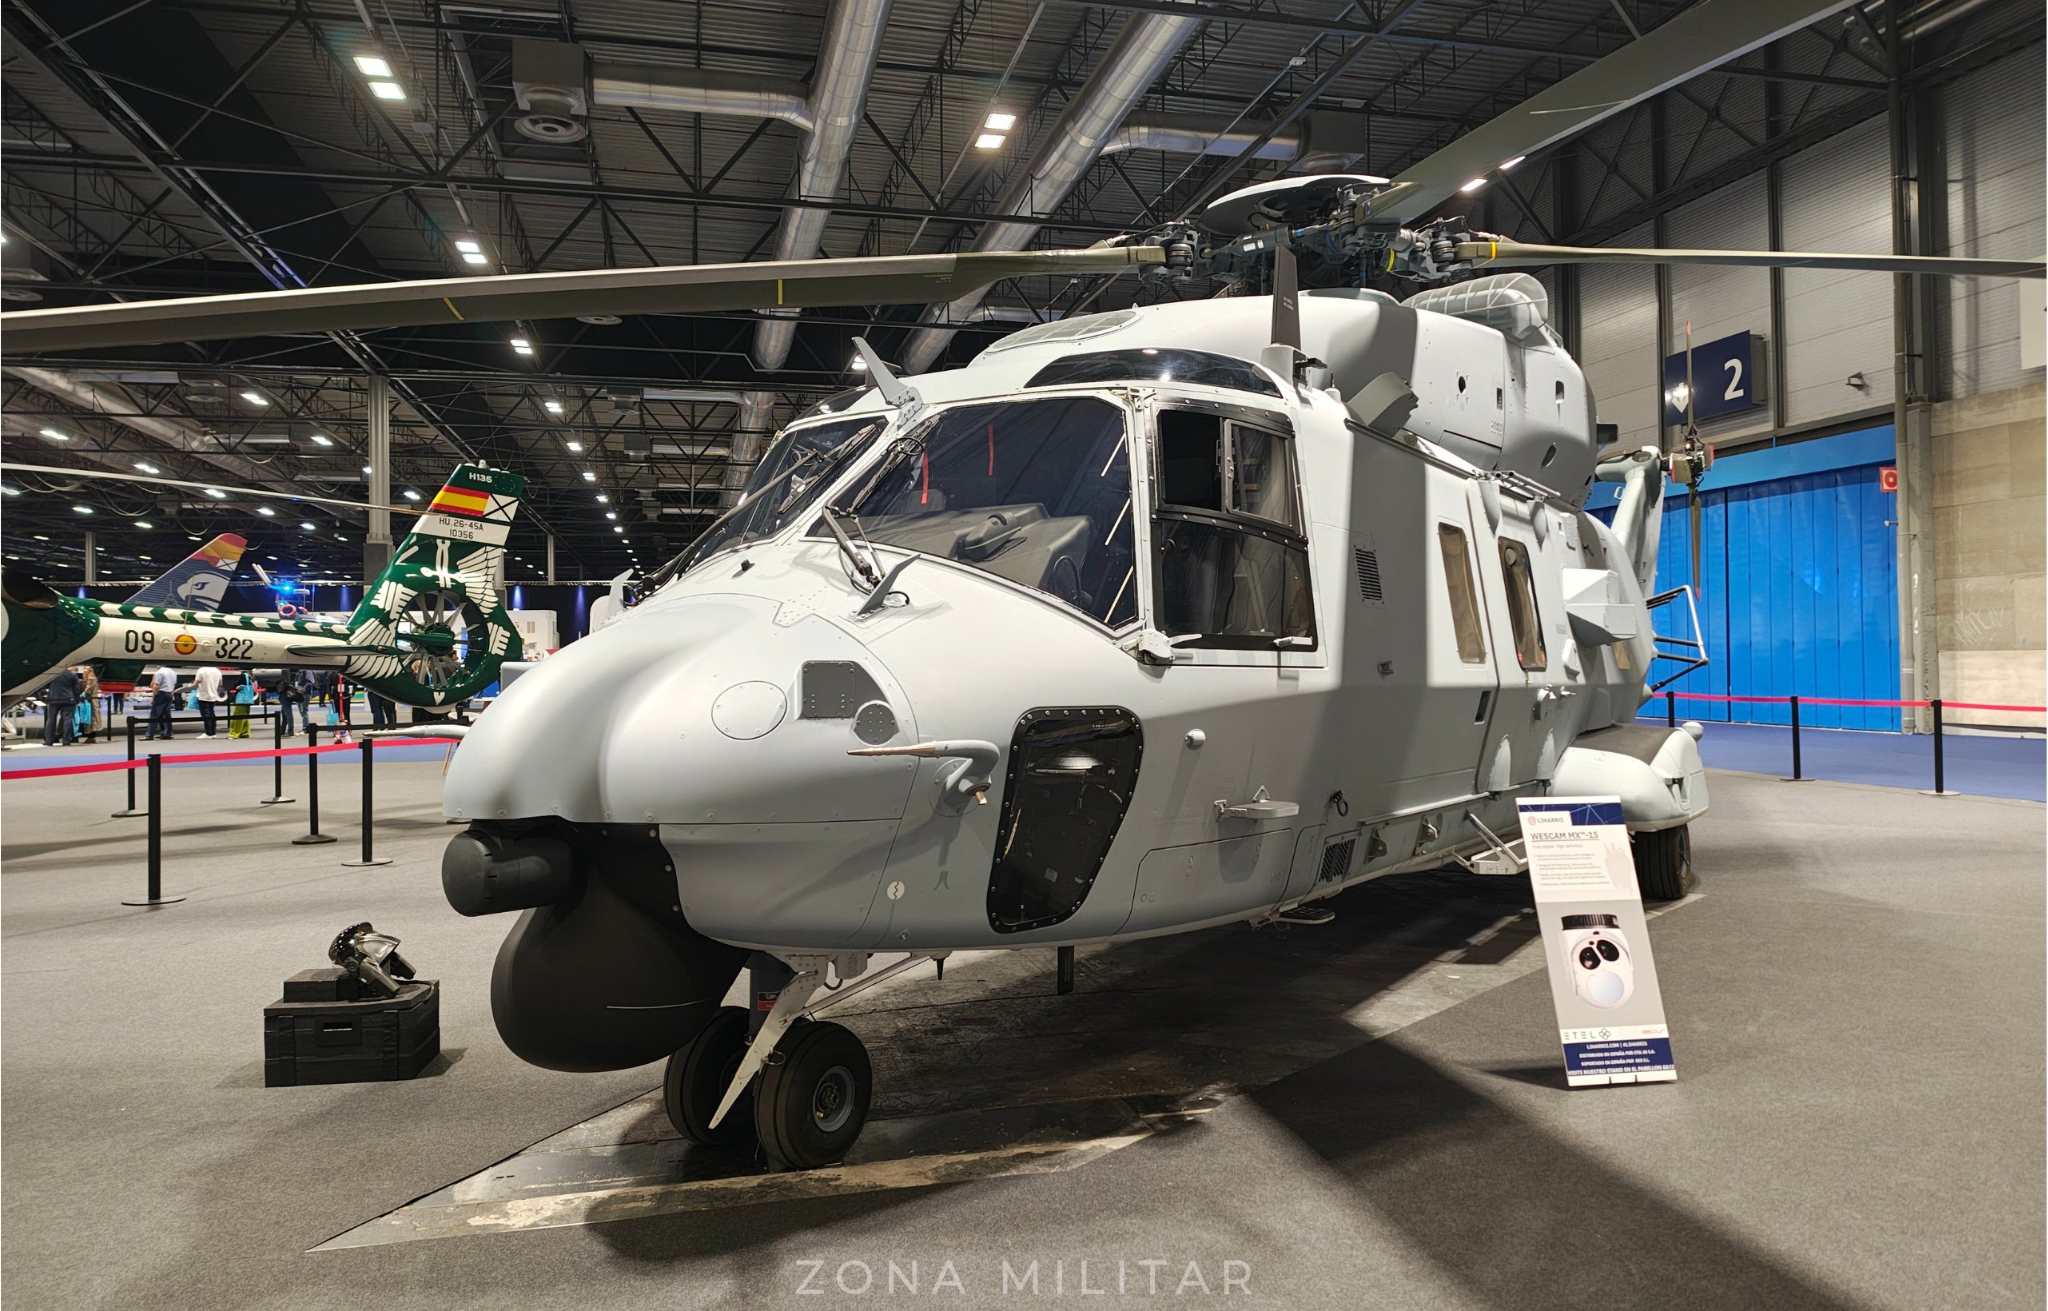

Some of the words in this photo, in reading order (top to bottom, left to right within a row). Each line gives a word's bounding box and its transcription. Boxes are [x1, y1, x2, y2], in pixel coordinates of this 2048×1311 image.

[1724, 358, 1744, 401] 2
[469, 472, 493, 483] H135
[125, 629, 155, 654] 09
[215, 637, 253, 660] 322
[1530, 832, 1566, 840] WESCAM
